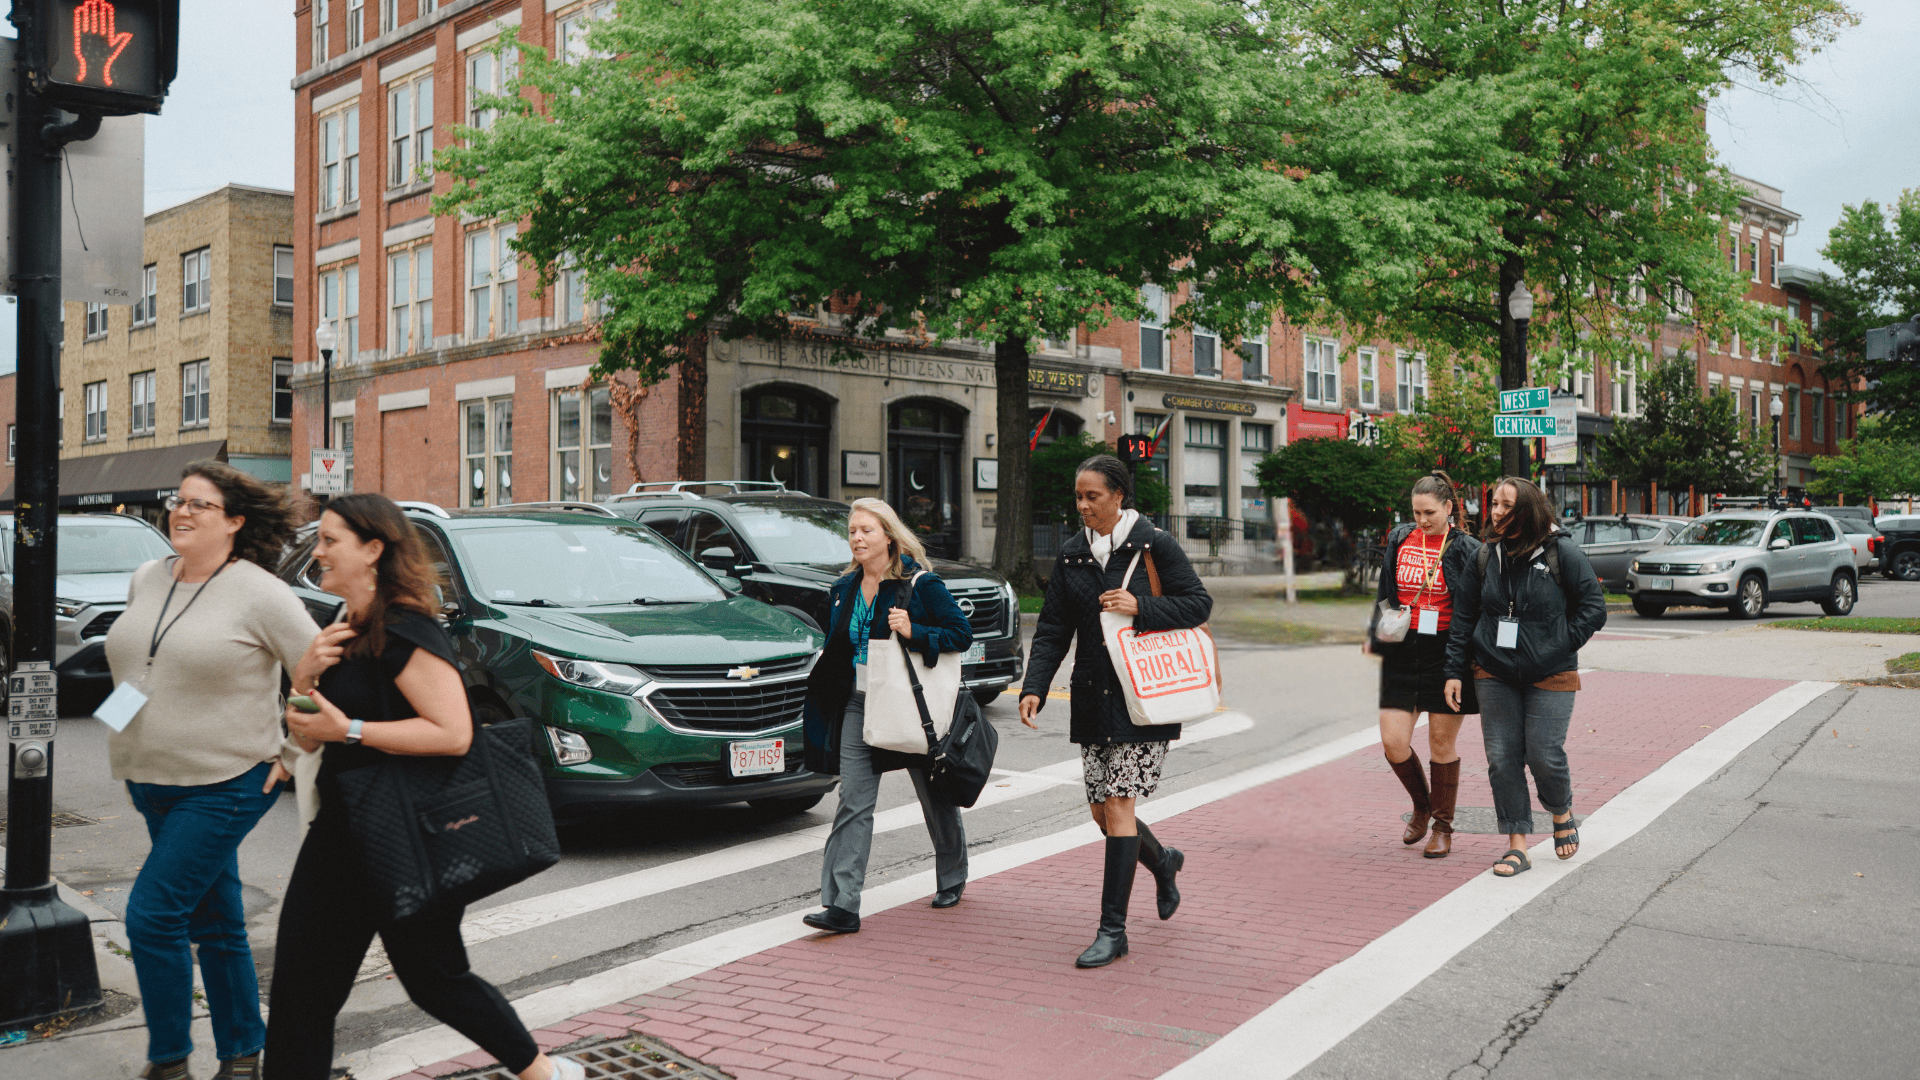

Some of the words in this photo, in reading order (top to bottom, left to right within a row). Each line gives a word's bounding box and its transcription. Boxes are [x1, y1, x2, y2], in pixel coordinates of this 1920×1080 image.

[757, 344, 788, 361] THE
[1027, 369, 1045, 384] NE
[1047, 371, 1084, 387] WEST
[1171, 395, 1202, 408] CHAMBER
[1204, 399, 1213, 409] OF
[1216, 400, 1252, 413] COMMERCE
[1503, 392, 1530, 409] WEST
[1537, 389, 1545, 401] ST
[1497, 418, 1543, 434] CENTRAL
[1545, 418, 1554, 429] SQ
[1130, 631, 1189, 656] RADICALLY
[1135, 648, 1202, 683] RURAL
[733, 751, 755, 768] 787
[759, 749, 781, 765] HS9
